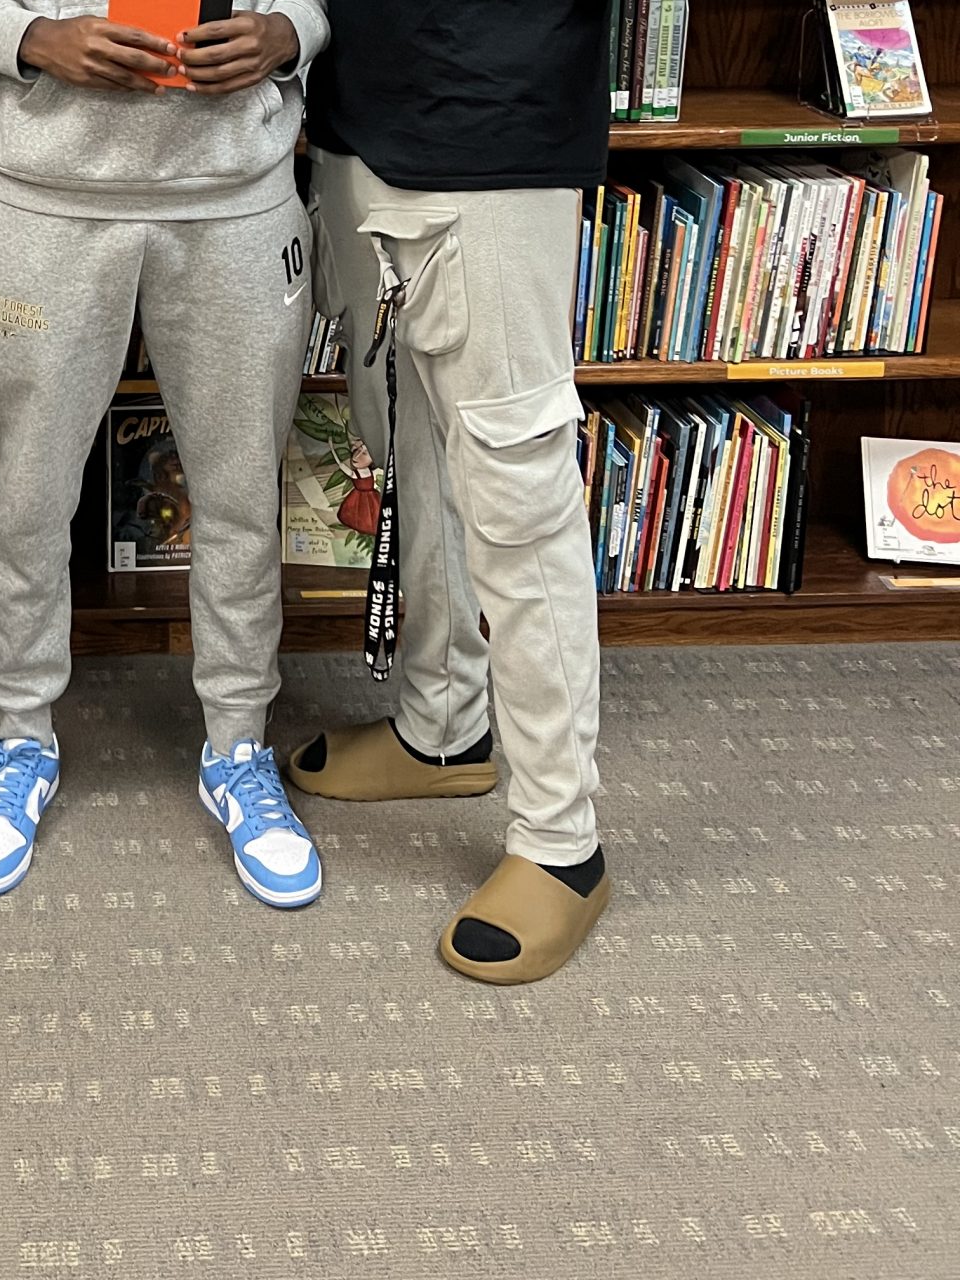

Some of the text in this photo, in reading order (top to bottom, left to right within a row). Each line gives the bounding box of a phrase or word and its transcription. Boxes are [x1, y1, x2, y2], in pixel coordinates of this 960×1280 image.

[783, 132, 819, 143] Junior
[281, 235, 304, 285] 10
[3, 297, 44, 317] FOREST
[1, 310, 50, 331] DEACONS
[768, 365, 844, 377] Picture Books
[917, 464, 957, 491] the
[912, 488, 960, 521] dot
